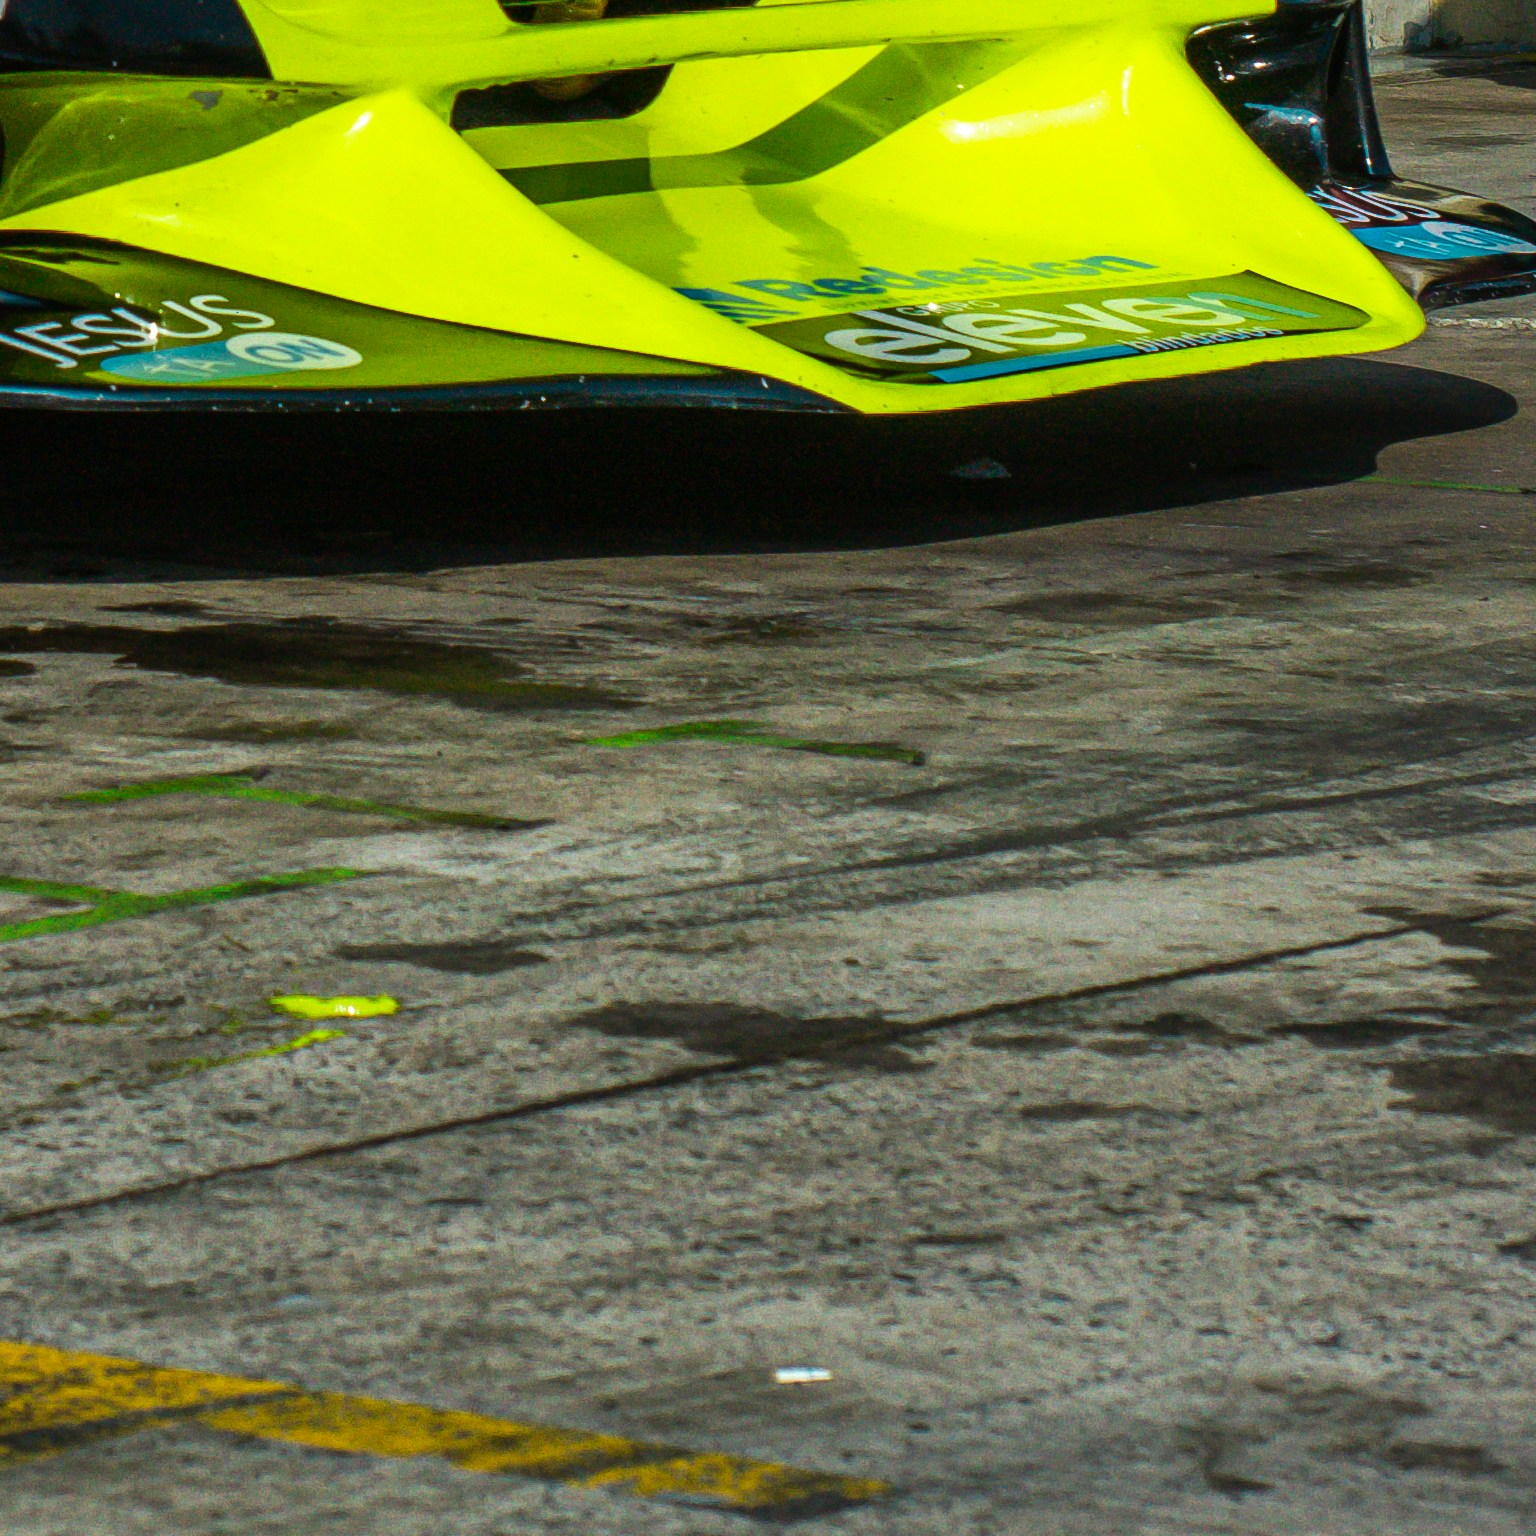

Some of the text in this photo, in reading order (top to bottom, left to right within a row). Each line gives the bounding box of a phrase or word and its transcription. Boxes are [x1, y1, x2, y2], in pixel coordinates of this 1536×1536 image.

[733, 255, 1161, 301] Redesign
[896, 299, 1001, 316] GRUPO
[823, 291, 1323, 364] eleven
[1115, 325, 1285, 353] blindados
[244, 338, 346, 365] ON
